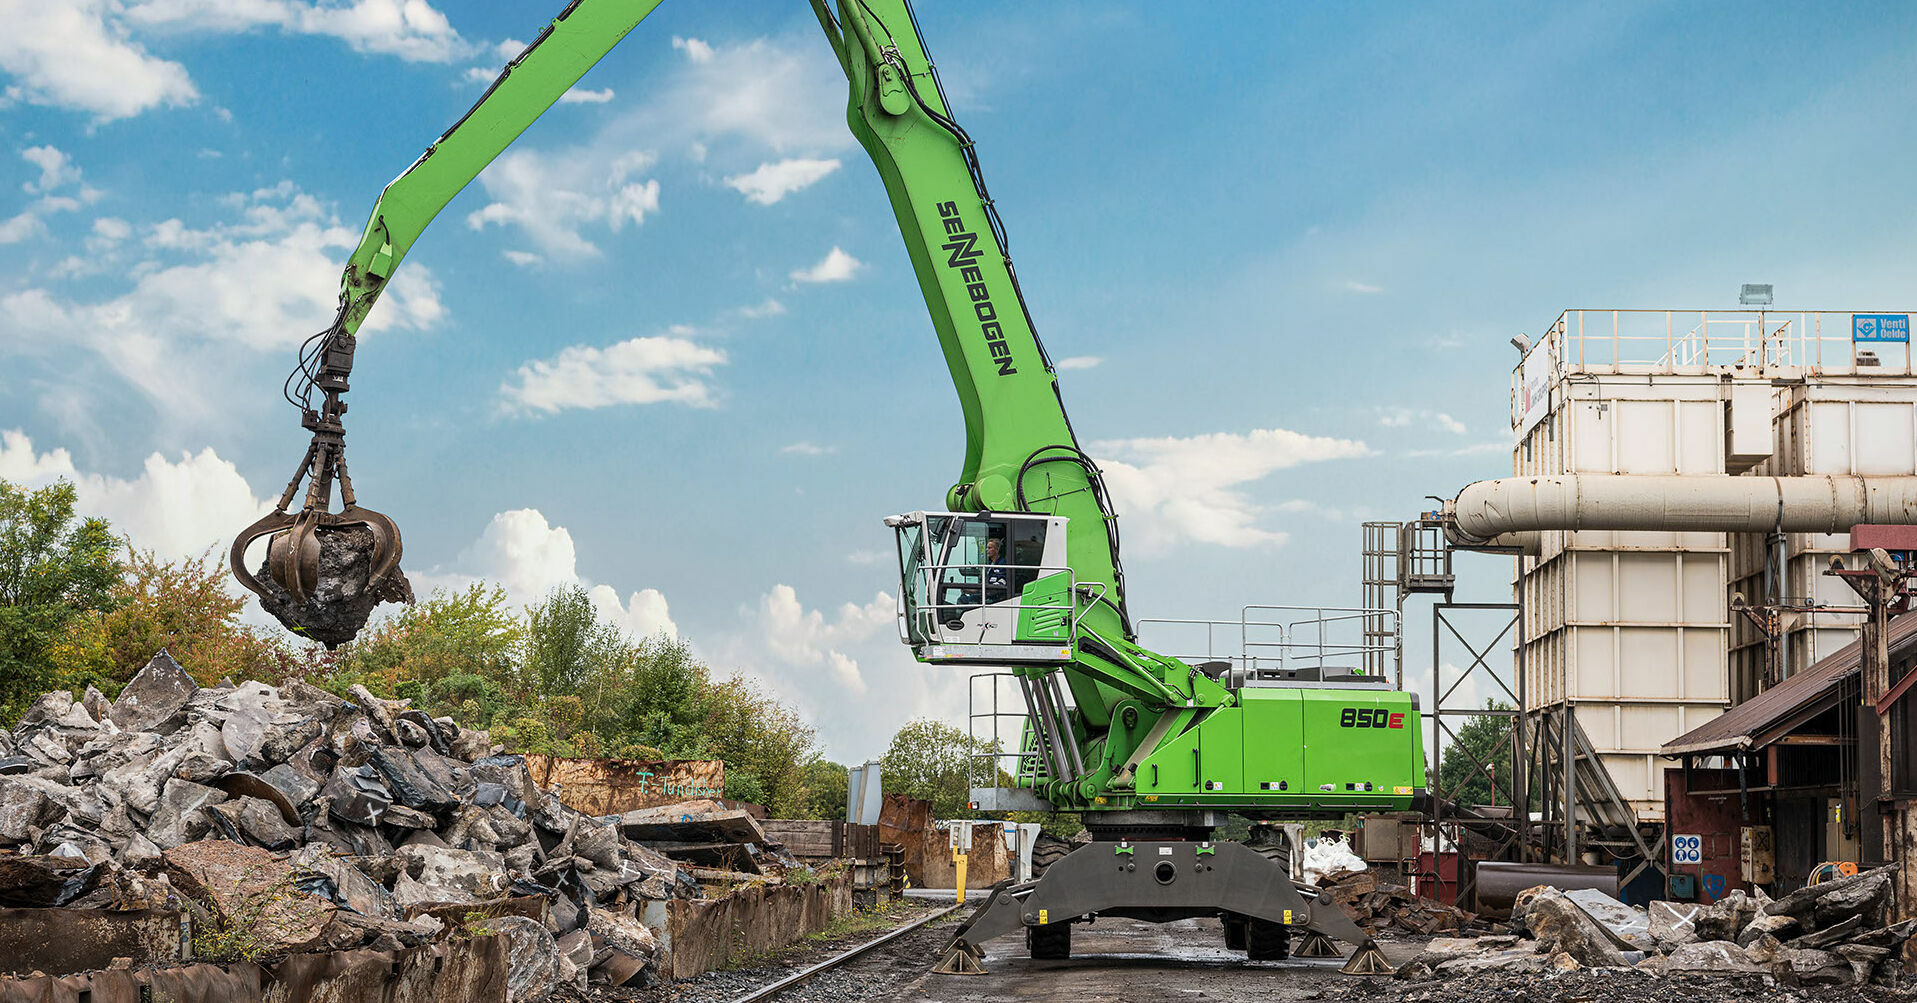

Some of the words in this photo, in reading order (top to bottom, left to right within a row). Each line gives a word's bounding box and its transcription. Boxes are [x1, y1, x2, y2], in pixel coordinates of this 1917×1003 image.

[936, 200, 1018, 377] SENNEBOGEN
[1880, 318, 1906, 329] Venti
[1880, 329, 1906, 339] Oelde
[1340, 708, 1405, 729] 850E
